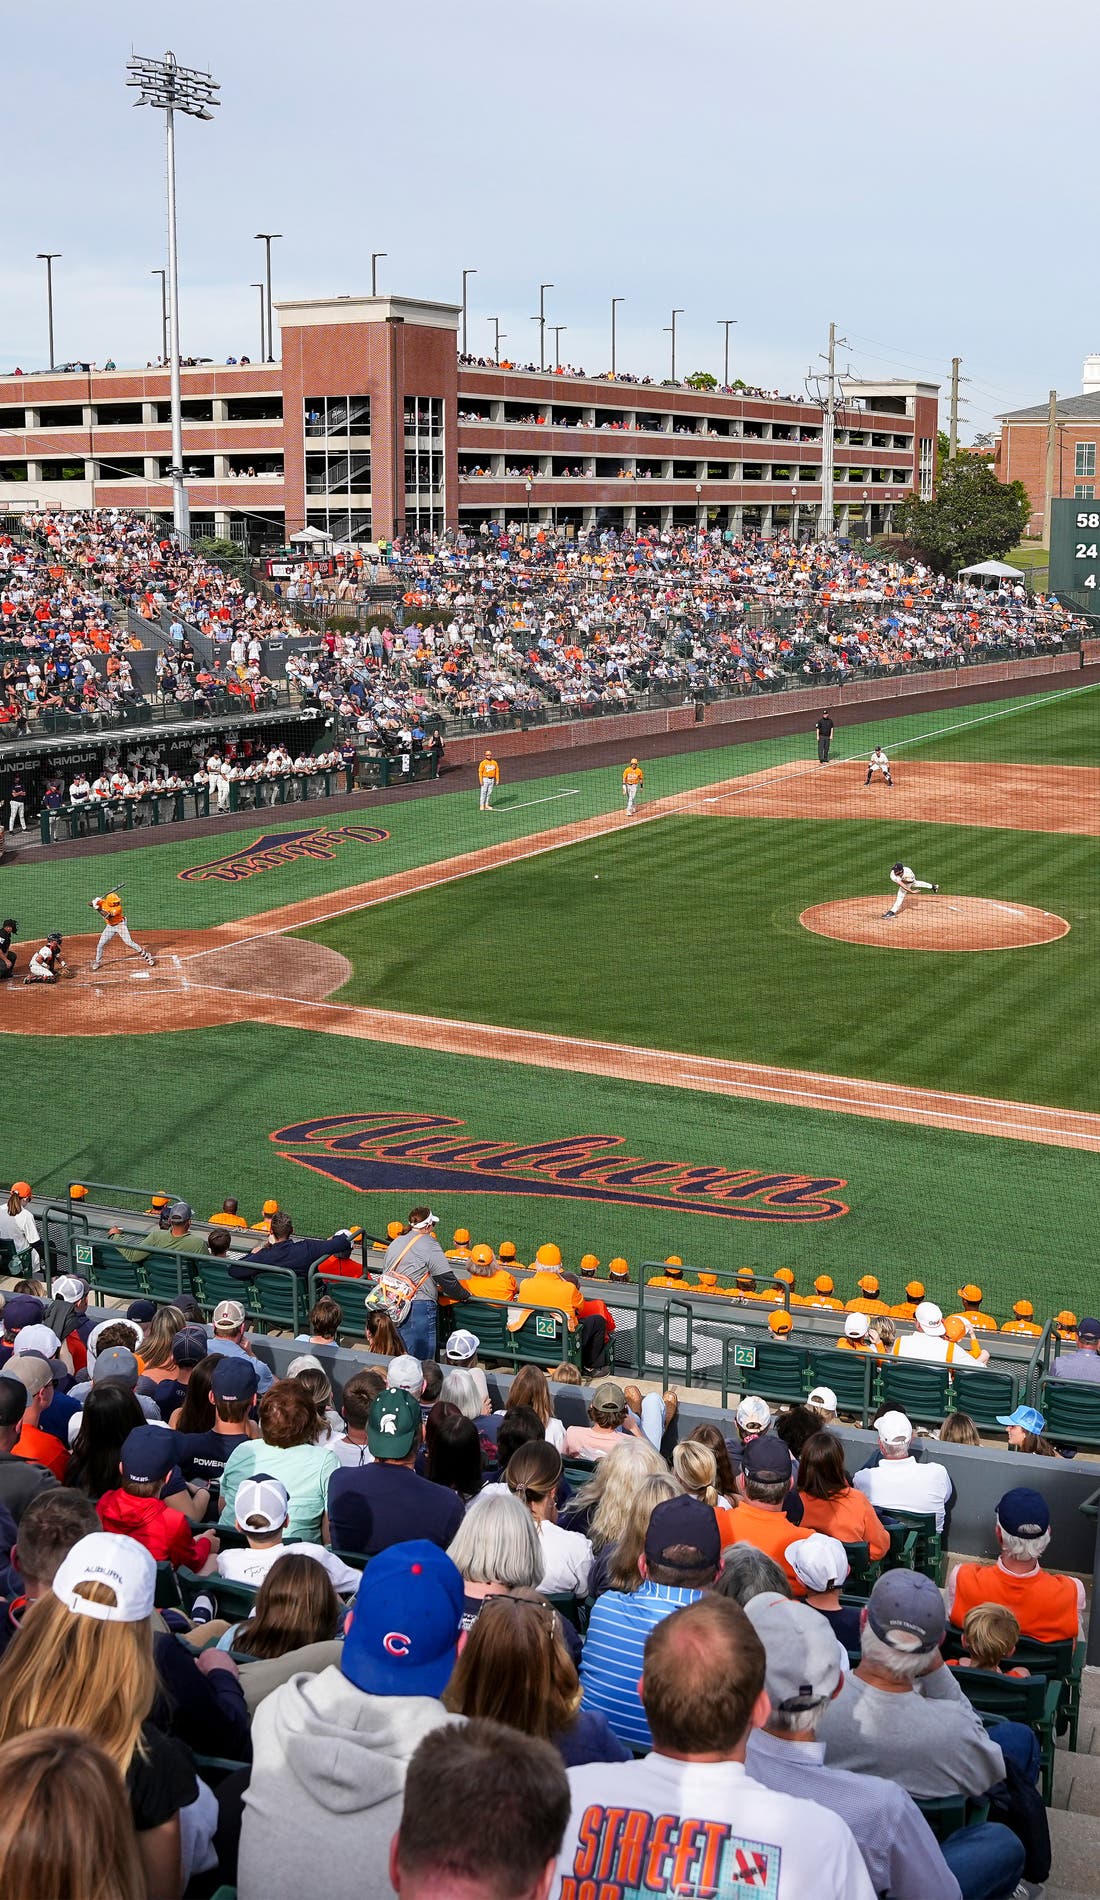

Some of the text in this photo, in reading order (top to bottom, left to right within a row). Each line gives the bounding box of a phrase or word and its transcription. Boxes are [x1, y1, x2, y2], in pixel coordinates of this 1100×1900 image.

[1077, 513, 1099, 528] 58
[1075, 543, 1098, 559] 24
[176, 826, 391, 882] Auburn
[269, 1111, 850, 1222] Auburn
[78, 1249, 91, 1260] 27
[538, 1321, 554, 1334] 26
[737, 1350, 753, 1363] 25
[193, 1457, 227, 1468] POWER
[84, 1566, 123, 1584] AUBURN
[383, 1631, 411, 1656] C
[573, 1804, 732, 1899] STREET
